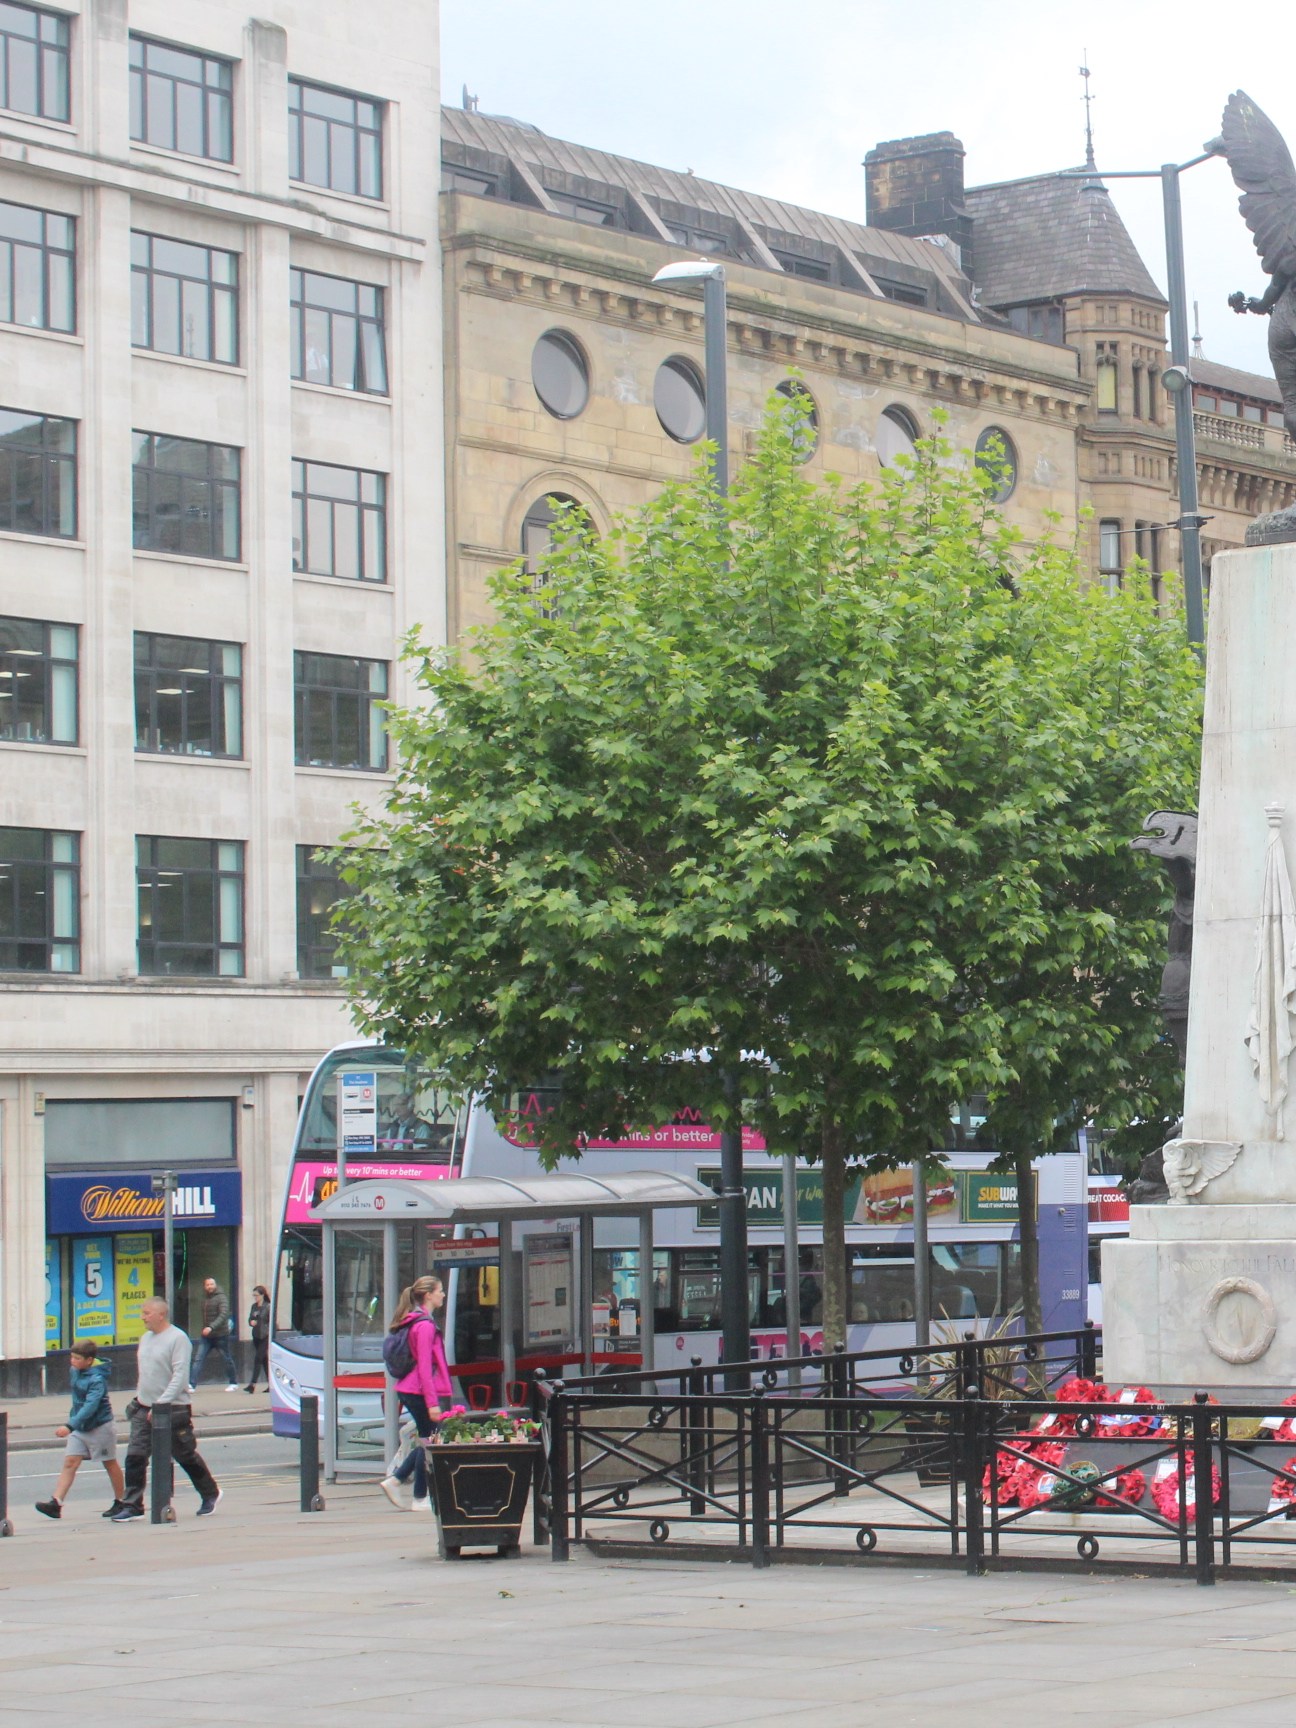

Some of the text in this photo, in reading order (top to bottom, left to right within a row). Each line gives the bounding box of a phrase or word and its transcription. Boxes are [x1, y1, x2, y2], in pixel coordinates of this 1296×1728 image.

[654, 1131, 668, 1142] or
[672, 1128, 714, 1142] better
[323, 1166, 333, 1174] Up
[346, 1168, 362, 1176] very
[372, 1168, 388, 1176] mins
[399, 1168, 422, 1176] better
[978, 1186, 1018, 1202] SUBWA
[1088, 1194, 1126, 1203] REAT COCA-C
[81, 1184, 216, 1223] William HILL
[86, 1262, 103, 1298] 5
[128, 1267, 140, 1287] 4
[122, 1291, 146, 1300] PLACES
[1062, 1289, 1079, 1300] 33889
